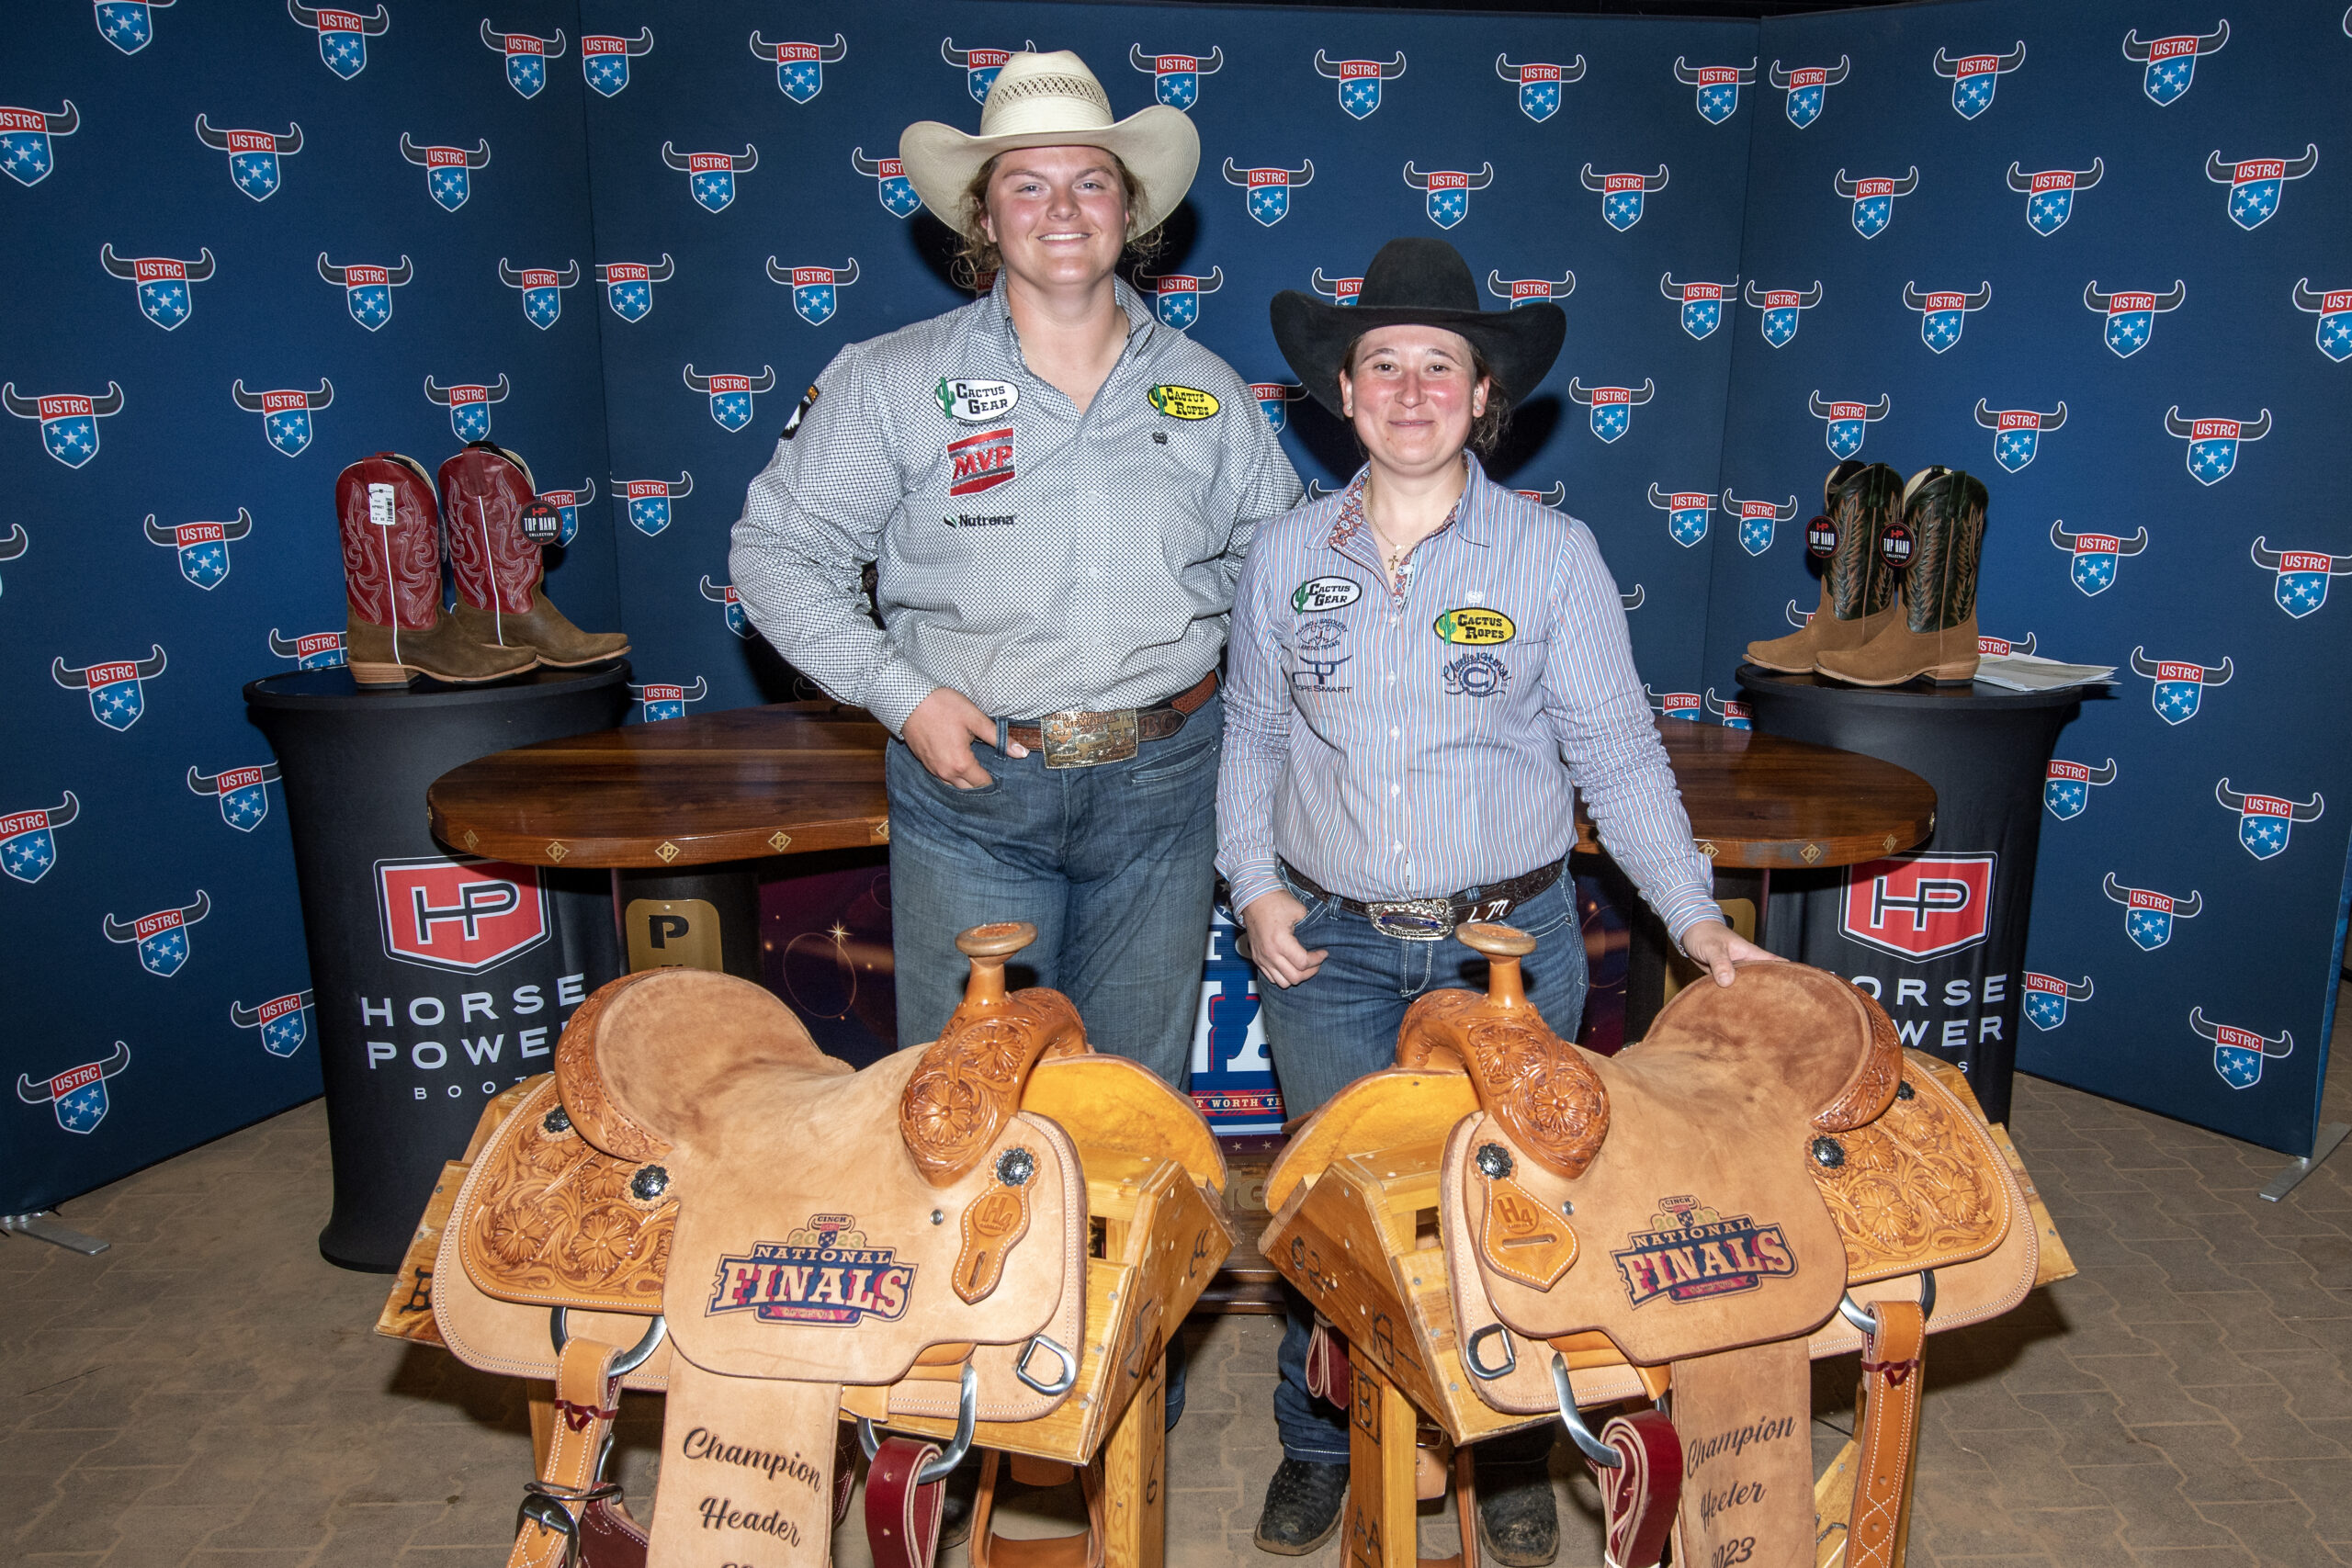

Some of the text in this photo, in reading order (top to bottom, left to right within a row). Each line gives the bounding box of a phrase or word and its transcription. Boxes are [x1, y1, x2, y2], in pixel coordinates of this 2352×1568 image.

[321, 13, 359, 30] USTRC
[508, 37, 541, 53] USTRC
[586, 39, 623, 52] USTRC
[2154, 39, 2194, 56] USTRC
[780, 46, 817, 59] USTRC
[971, 52, 1007, 65] USTRC
[1159, 58, 1194, 71] USTRC
[1343, 63, 1377, 76] USTRC
[1960, 59, 1996, 73] USTRC
[1524, 67, 1558, 79] USTRC
[1702, 70, 1736, 82] USTRC
[1792, 71, 1824, 85] USTRC
[232, 133, 272, 150] USTRC
[429, 150, 464, 164] USTRC
[693, 156, 729, 169] USTRC
[882, 162, 902, 174] UST
[2238, 163, 2280, 178] USTRC
[1251, 172, 1285, 184] USTRC
[1431, 175, 1465, 186] USTRC
[1608, 177, 1641, 189] USTRC
[2035, 175, 2072, 188] USTRC
[1859, 182, 1891, 194] USTRC
[139, 263, 182, 277] USTRC
[349, 269, 385, 283] USTRC
[610, 266, 646, 278] USTRC
[796, 270, 831, 282] USTRC
[525, 273, 556, 285] USTRC
[1161, 278, 1195, 290] USTRC
[1340, 281, 1361, 292] UST
[1515, 283, 1548, 295] USTRC
[1687, 286, 1719, 298] USTRC
[1768, 294, 1797, 306] USTRC
[1928, 296, 1962, 308] USTRC
[2113, 296, 2152, 309] USTRC
[2326, 295, 2352, 309] UST
[712, 378, 748, 389] USTRC
[956, 382, 1006, 399] CACTUS
[266, 394, 304, 408] USTRC
[452, 389, 484, 401] USTRC
[1166, 387, 1205, 402] CACTUS
[1595, 390, 1628, 402] USTRC
[42, 399, 89, 414] USTRC
[967, 399, 1009, 414] GEAR
[1174, 400, 1209, 415] ROPES
[1833, 405, 1864, 418] USTRC
[2002, 414, 2037, 427] USTRC
[2196, 423, 2236, 436] USTRC
[952, 445, 1013, 480] MVP
[630, 484, 665, 495] USTRC
[1674, 496, 1705, 507] USTRC
[1745, 503, 1773, 517] USTRC
[524, 516, 557, 532] TOP HAND
[180, 525, 220, 541] USTRC
[1809, 530, 1820, 545] TOP
[1883, 537, 1894, 552] TOP
[2079, 536, 2116, 551] USTRC
[2284, 555, 2327, 570] USTRC
[1308, 582, 1351, 596] CACTUS
[1314, 593, 1348, 606] GEAR
[1457, 614, 1503, 627] CACTUS
[1464, 626, 1505, 640] ROPES
[300, 636, 337, 652] USTRC
[90, 664, 134, 682] USTRC
[2161, 664, 2199, 681] USTRC
[647, 687, 680, 698] USTRC
[1667, 696, 1698, 707] USTRC
[2051, 762, 2086, 779] USTRC
[220, 770, 259, 788] USTRC
[2247, 797, 2289, 816] USTRC
[0, 814, 44, 834] USTRC
[1869, 876, 1971, 932] HP
[2132, 892, 2170, 910] USTRC
[411, 879, 520, 945] HP
[139, 912, 180, 933] USTRC
[649, 914, 689, 949] P
[1849, 973, 2007, 1007] ORSE
[2030, 976, 2064, 994] USTRC
[360, 973, 586, 1027] HORSE
[262, 997, 298, 1018] USTRC
[1891, 1015, 2003, 1047] WER
[367, 1021, 568, 1070] POWE
[2221, 1028, 2259, 1049] USTRC
[55, 1066, 98, 1091] USTRC
[1212, 1099, 1259, 1109] WORTH
[1664, 1197, 1691, 1206] CINCH
[1634, 1219, 1754, 1249] NATIONAL
[755, 1246, 891, 1264] NATIONAL
[1618, 1230, 1792, 1302] FINALS
[714, 1261, 910, 1317] FINALS
[1686, 1415, 1797, 1480] Champion
[683, 1426, 821, 1493] Champion
[1700, 1480, 1768, 1533] Heeler
[698, 1495, 801, 1548] Header
